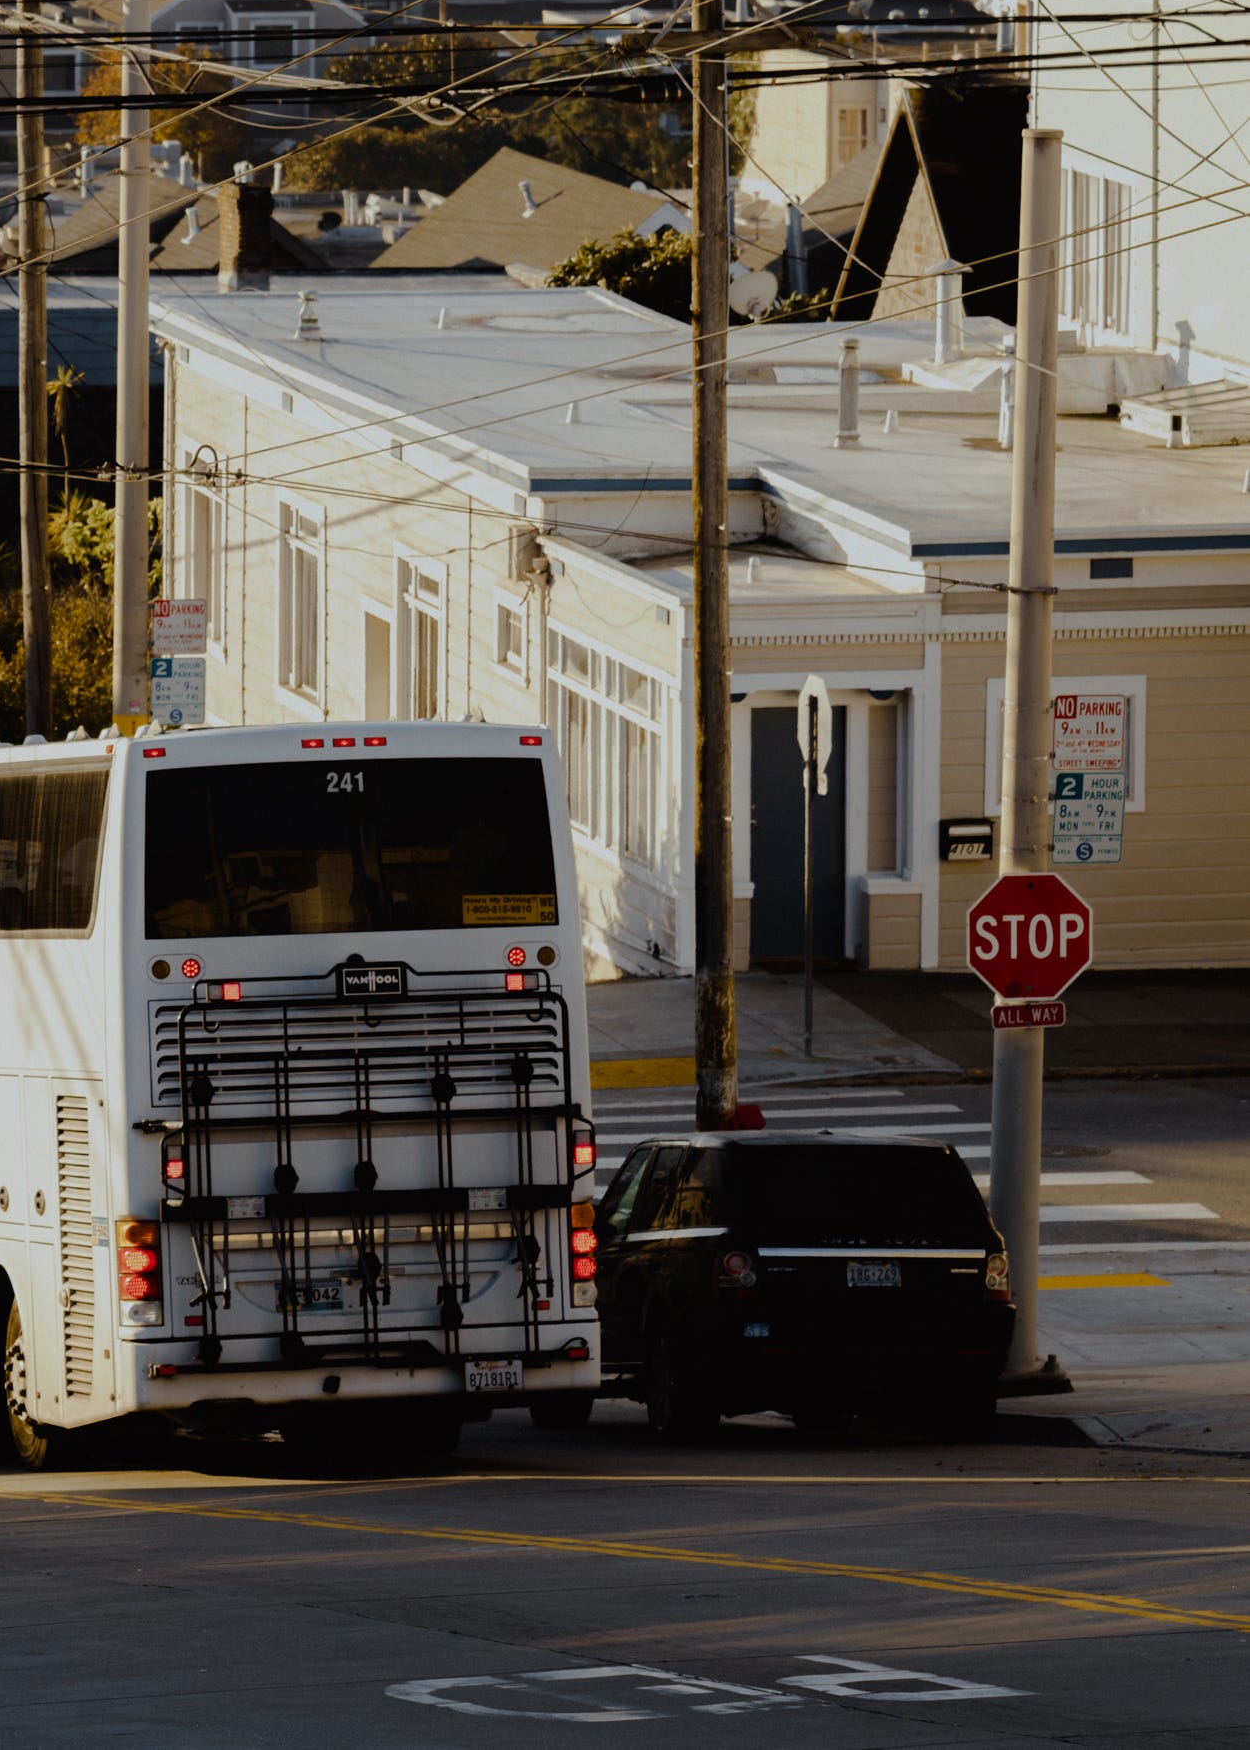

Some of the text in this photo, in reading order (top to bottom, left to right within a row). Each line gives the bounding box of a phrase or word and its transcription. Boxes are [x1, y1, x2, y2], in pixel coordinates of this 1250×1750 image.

[154, 601, 205, 616] NO PARKING
[155, 661, 168, 677] 2
[1056, 697, 1122, 718] NO PARKING
[172, 710, 181, 722] S
[326, 771, 365, 793] 241
[1061, 776, 1119, 797] 2 HOUR
[1084, 790, 1124, 801] PARKING
[1059, 821, 1079, 832] MON
[1099, 821, 1115, 831] FRI
[1079, 844, 1091, 859] S
[540, 897, 554, 907] WE
[540, 911, 554, 922] 50
[974, 913, 1085, 961] STOP
[997, 1007, 1060, 1025] ALL WAY
[469, 1371, 519, 1387] 87181R1
